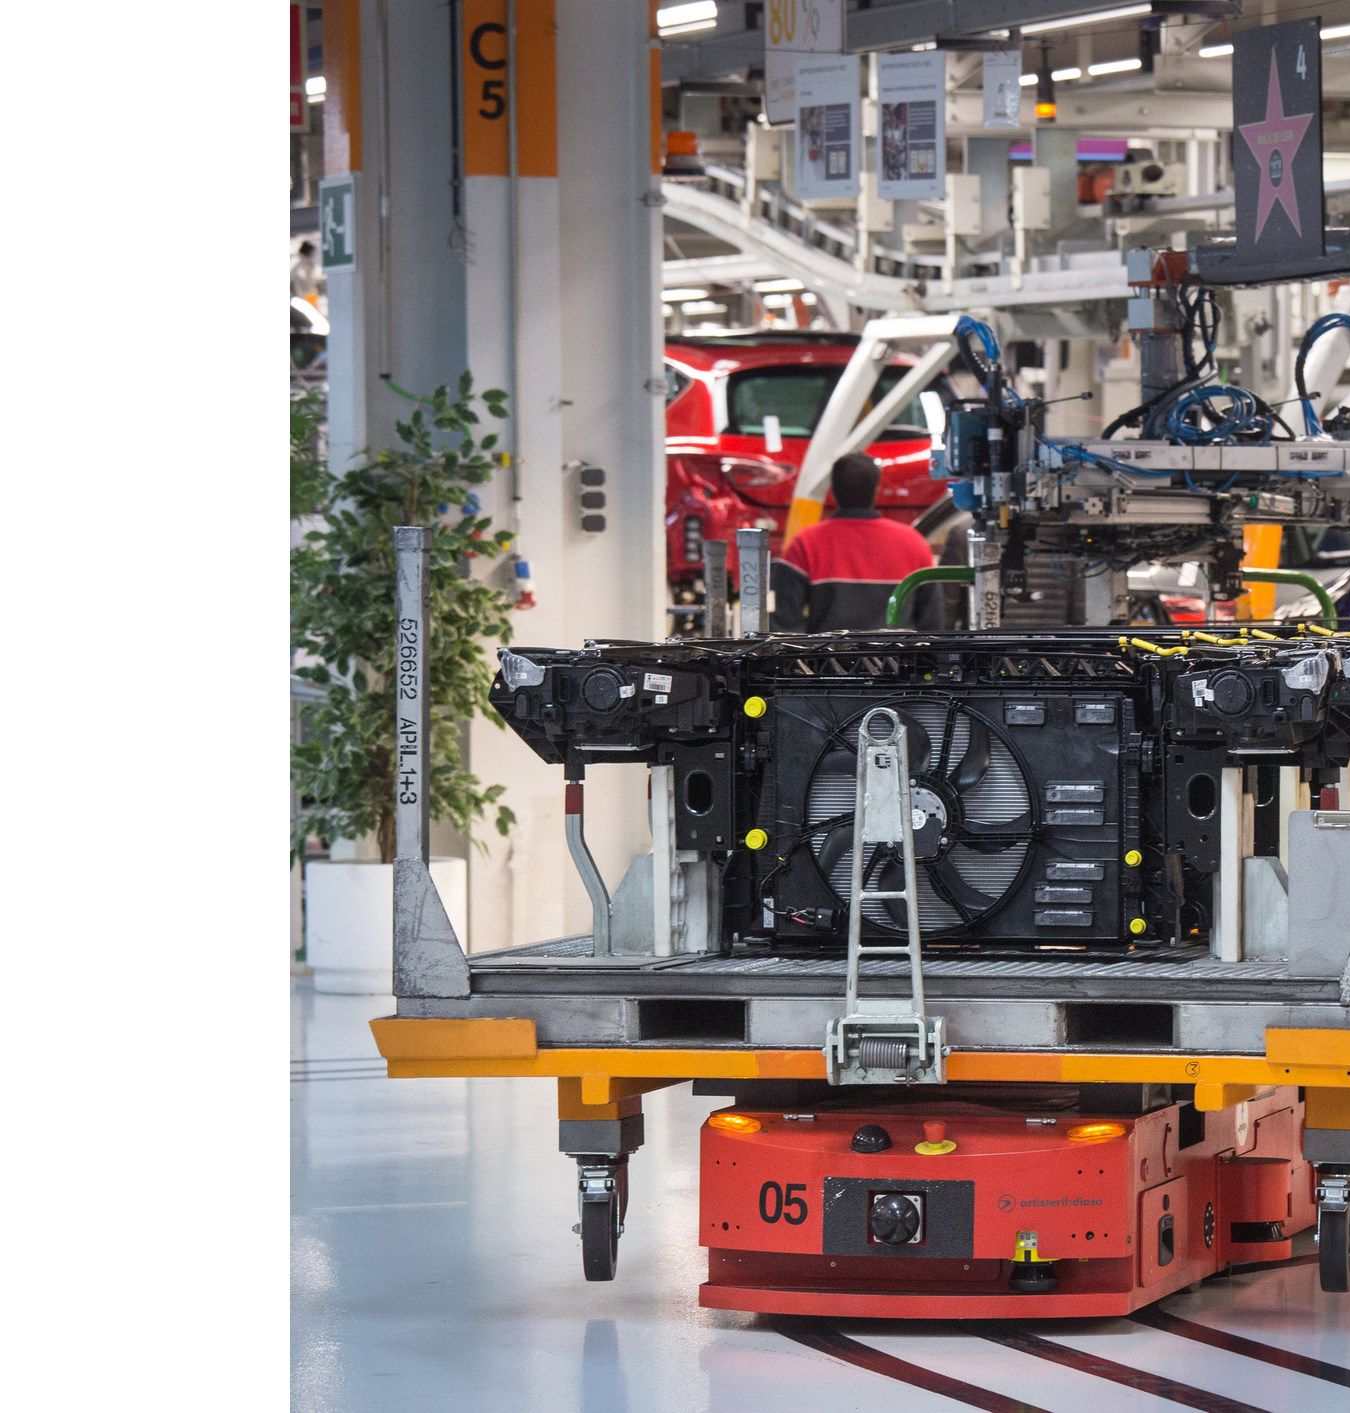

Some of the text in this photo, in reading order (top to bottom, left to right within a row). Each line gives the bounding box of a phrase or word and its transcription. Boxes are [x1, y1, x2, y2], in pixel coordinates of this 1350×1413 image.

[470, 22, 506, 70] C
[1296, 45, 1307, 79] 4
[479, 80, 505, 120] 5
[742, 561, 758, 596] 022
[400, 617, 418, 700] 526652
[759, 1180, 808, 1226] 05
